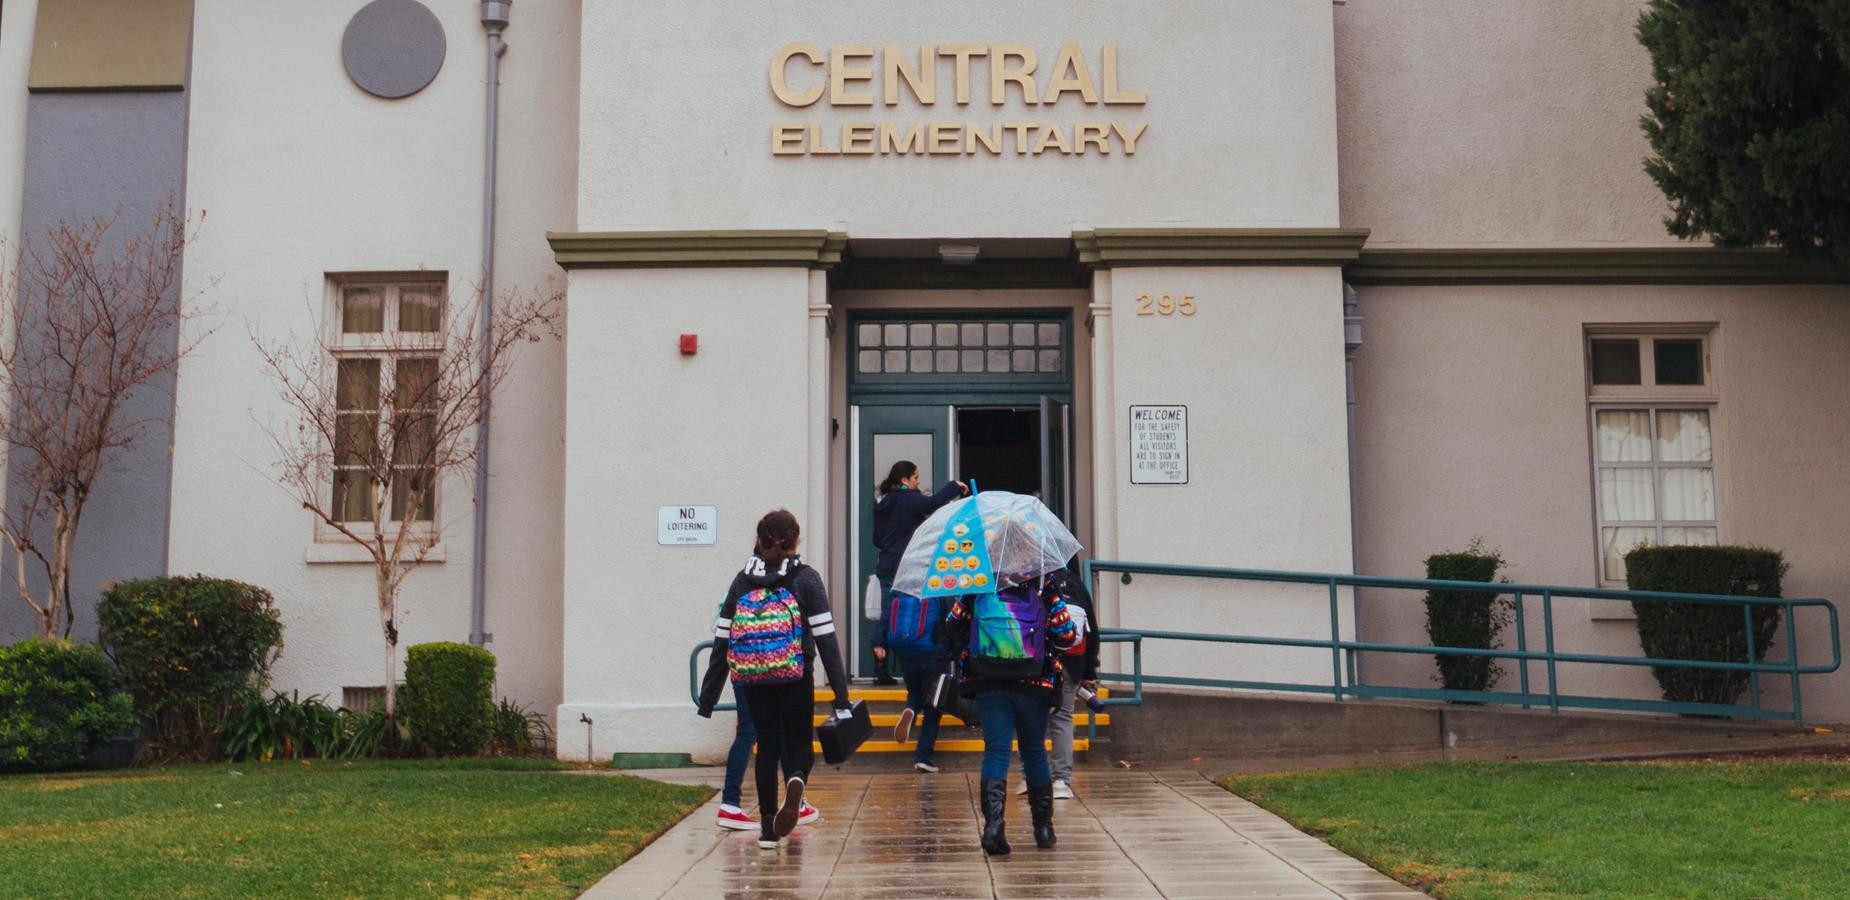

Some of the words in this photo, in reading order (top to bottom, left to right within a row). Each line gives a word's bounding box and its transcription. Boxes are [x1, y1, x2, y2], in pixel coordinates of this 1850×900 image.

[769, 42, 1147, 107] CENTRAL
[772, 122, 1148, 156] ELEMENTARY
[1135, 291, 1197, 316] 295
[1135, 409, 1182, 421] WELCOME
[1135, 422, 1145, 431] FOR
[1148, 422, 1158, 431] THE
[1161, 422, 1180, 431] SAFETY
[1139, 432, 1146, 441] OF
[1149, 432, 1177, 441] STUDENTS
[1139, 442, 1150, 451] ALL
[1152, 442, 1177, 451] VISITORS
[1136, 451, 1147, 460] ARE
[1149, 451, 1157, 460] TO
[1159, 451, 1172, 460] SIGN
[1174, 451, 1181, 460] IN
[1138, 461, 1145, 470] AT
[1147, 461, 1157, 470] THE
[1159, 461, 1179, 470] OFFICE
[679, 507, 696, 520] NO
[667, 522, 708, 531] LOITERING
